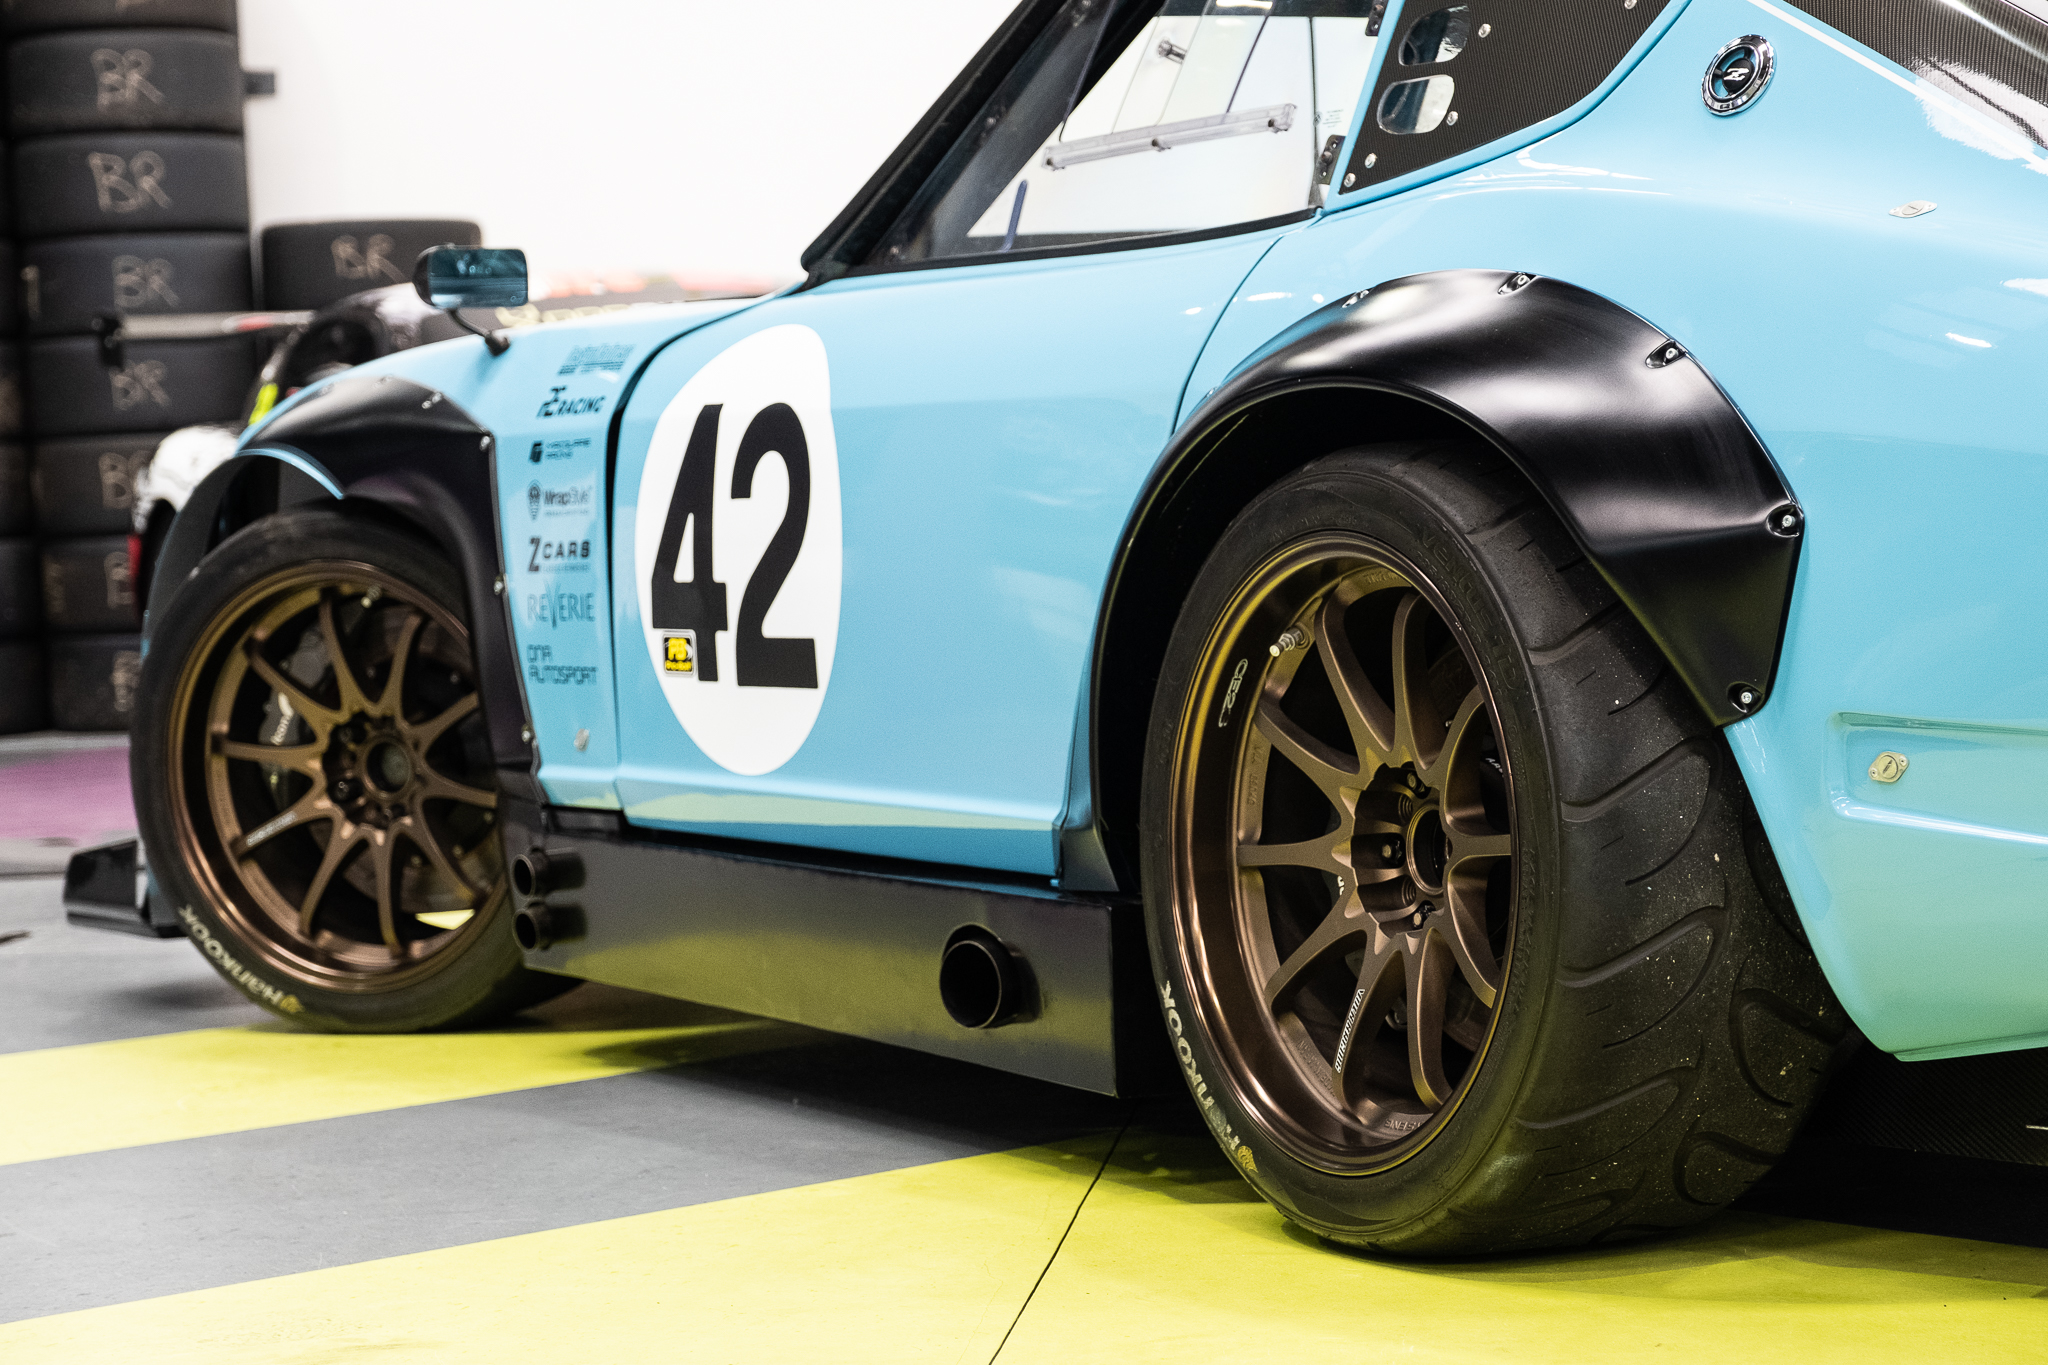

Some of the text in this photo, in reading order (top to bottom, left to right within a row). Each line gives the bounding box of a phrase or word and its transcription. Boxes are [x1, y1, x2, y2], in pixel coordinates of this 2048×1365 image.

[88, 150, 171, 213] BR
[651, 402, 818, 689] 42
[527, 582, 596, 629] REVERIE
